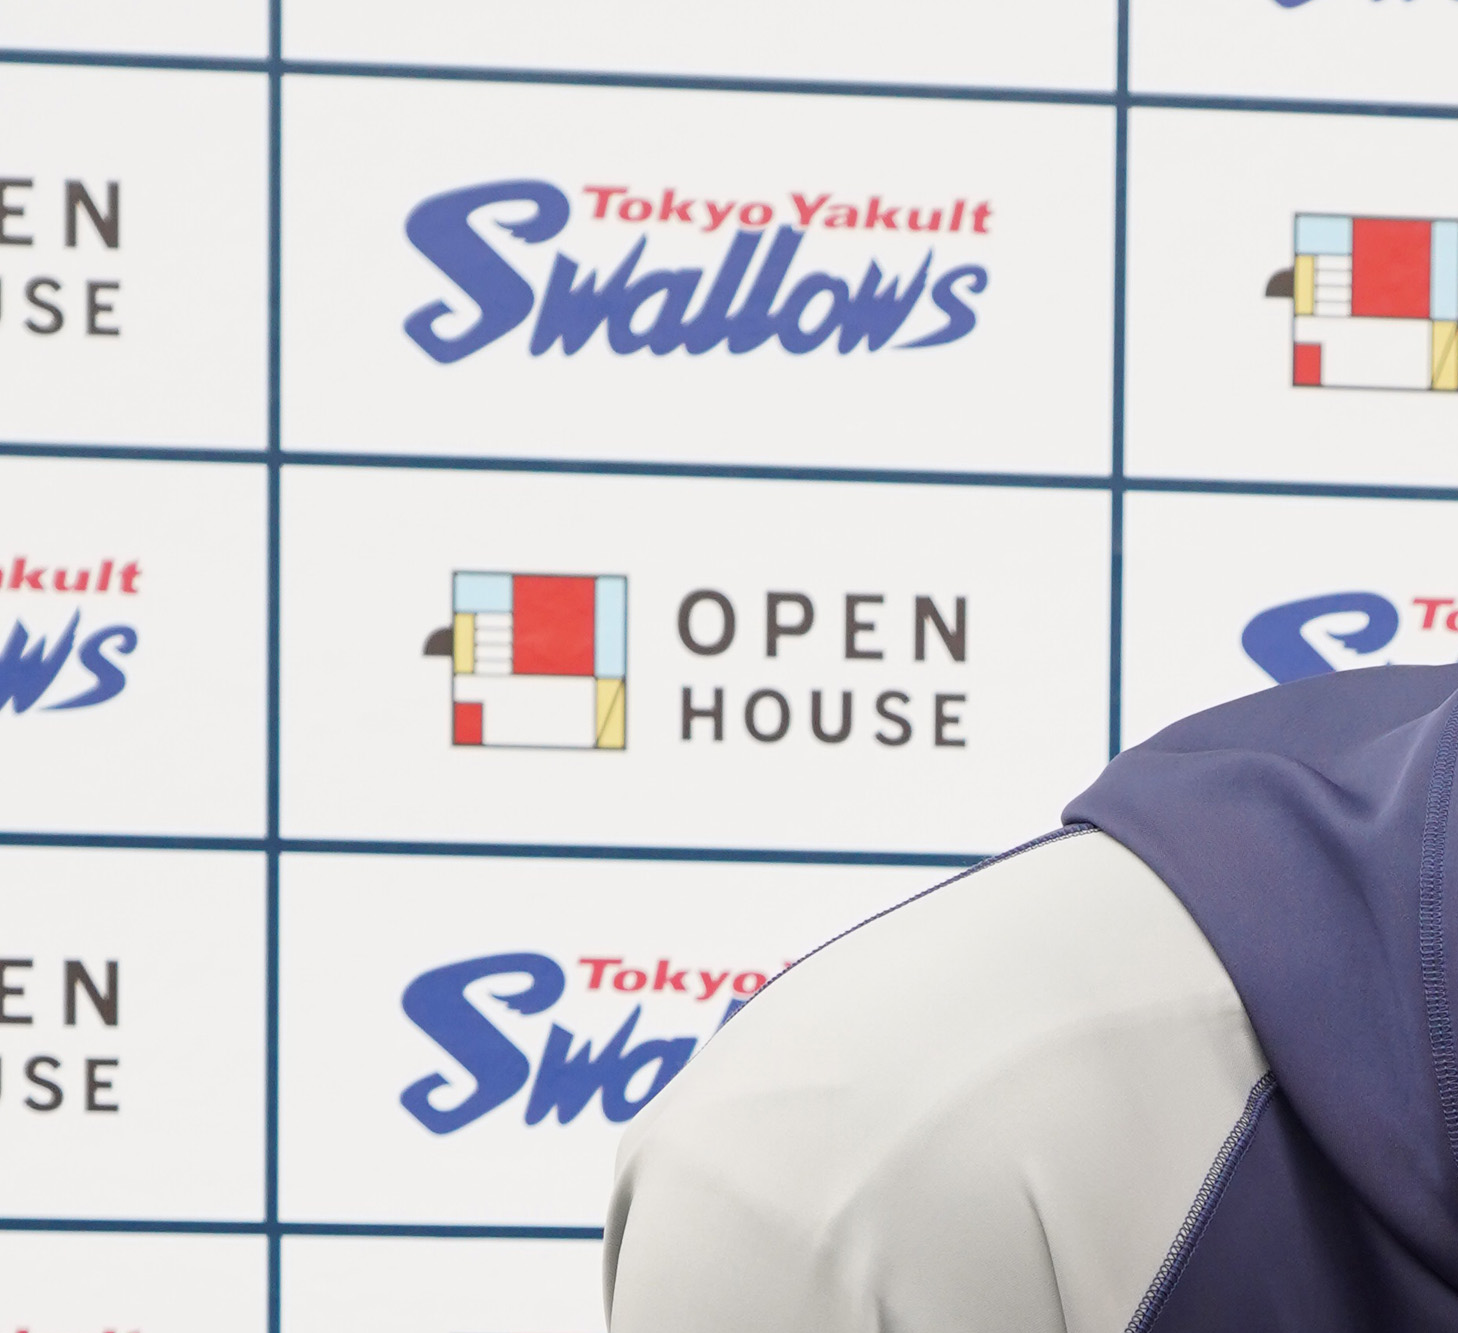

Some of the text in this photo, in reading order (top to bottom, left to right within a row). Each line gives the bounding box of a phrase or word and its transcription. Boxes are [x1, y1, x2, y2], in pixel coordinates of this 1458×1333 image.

[583, 185, 992, 235] Tokyo Yakult
[403, 179, 989, 365] Swallows
[0, 276, 120, 337] SE
[0, 557, 141, 595] kult
[677, 589, 968, 663] OPEN
[681, 686, 968, 748] HOUSE
[578, 957, 768, 1002] Tokyo
[0, 1055, 120, 1113] SE
